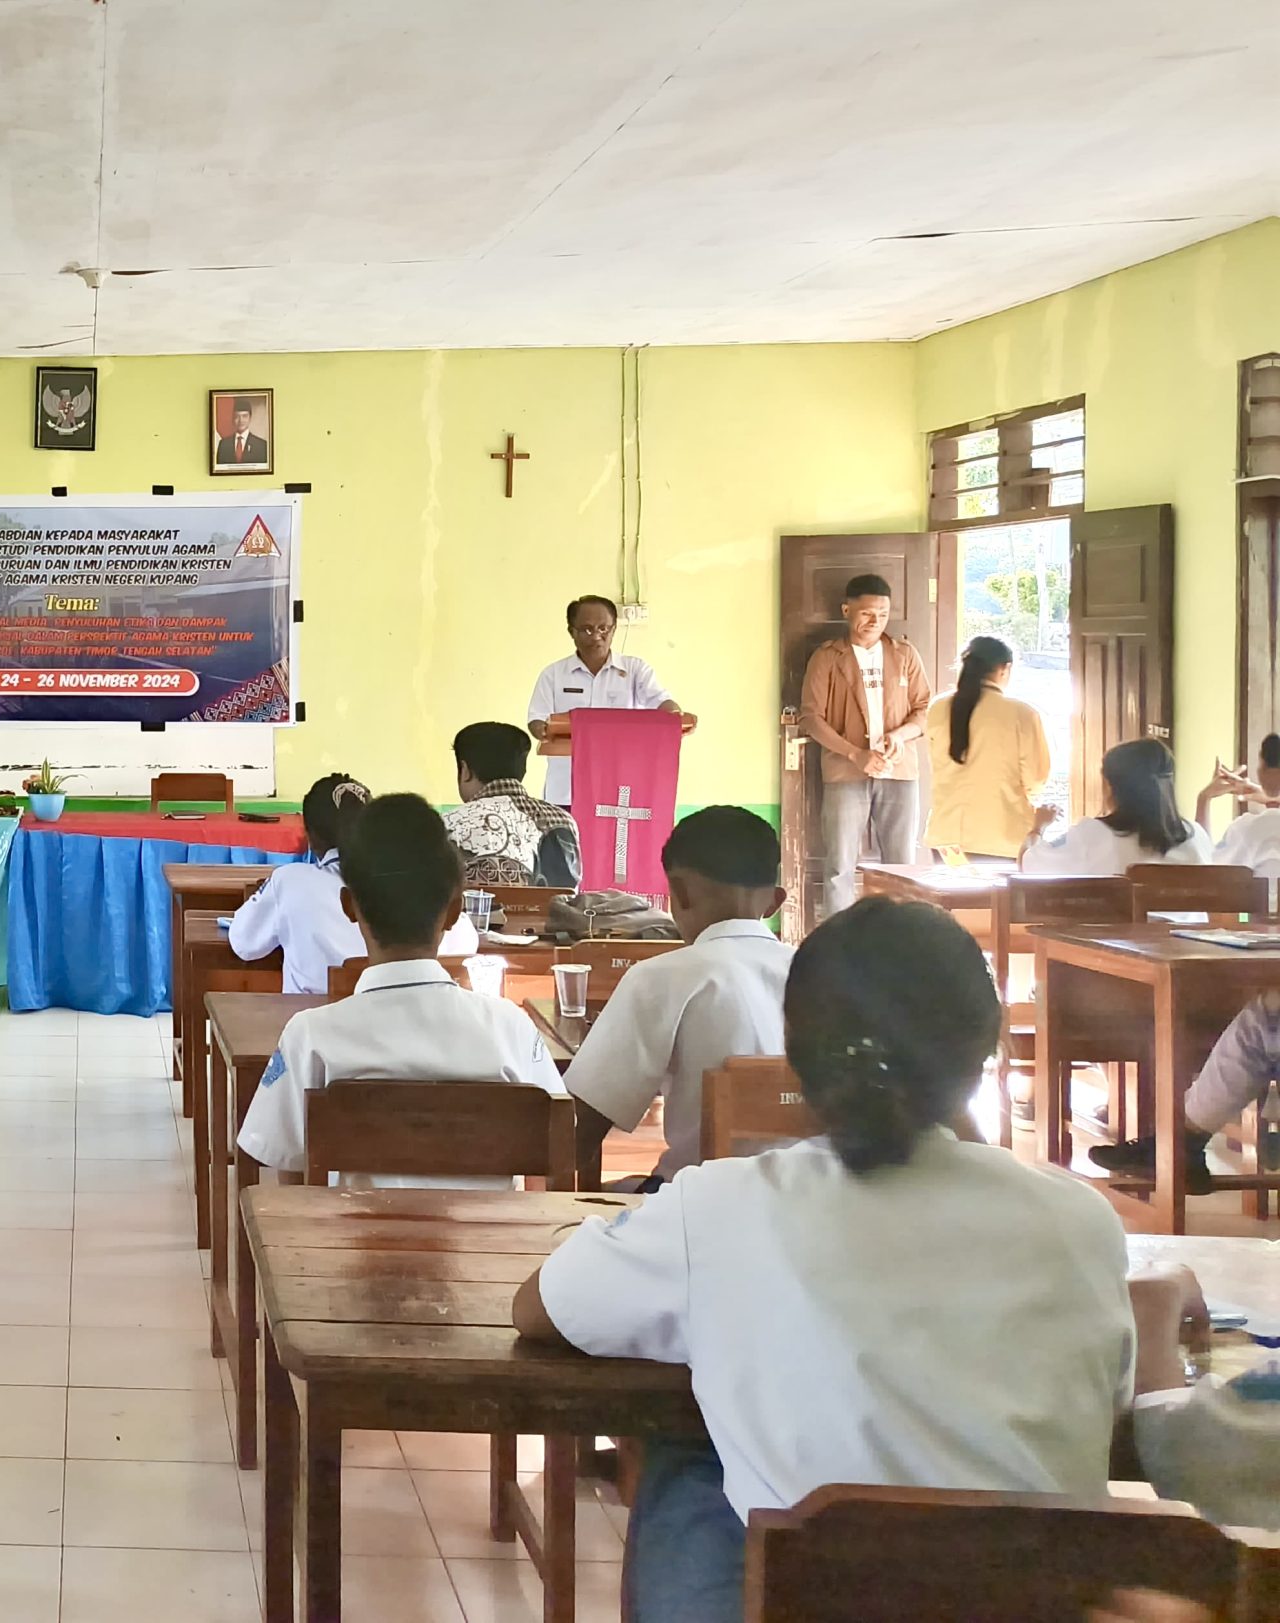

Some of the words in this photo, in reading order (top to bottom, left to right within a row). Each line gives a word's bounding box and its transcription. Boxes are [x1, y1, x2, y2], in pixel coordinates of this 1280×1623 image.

[45, 529, 93, 541] KEPADA
[96, 529, 181, 541] MASYARAKAT
[32, 544, 104, 556] PENDIDIKAN
[108, 544, 168, 556] PENYULUH
[172, 544, 216, 555] AGAMA
[45, 559, 70, 570] DAN
[73, 559, 102, 570] ILMU
[106, 559, 177, 570] PENDIDIKAN
[181, 559, 232, 570] KRISTEN
[4, 574, 48, 585] AGAMA
[51, 574, 101, 585] KRISTEN
[104, 574, 146, 585] NEGERI
[149, 574, 199, 585] KUPANG
[45, 593, 100, 611] Tema:
[55, 617, 121, 627] PENYULUHAN
[124, 617, 154, 627] ETIKA
[157, 617, 180, 627] DAN
[182, 617, 228, 627] DAMPAK
[66, 631, 128, 641] PERSPEKTIF
[131, 631, 169, 641] AGAMA
[172, 631, 217, 641] KRISTEN
[218, 631, 254, 642] UNTUK
[20, 646, 82, 656] KABUPATEN
[85, 646, 118, 656] TIMOR
[123, 646, 163, 656] TENGAH
[0, 674, 20, 687] 24
[37, 674, 55, 687] 26
[59, 673, 138, 688] NOVEMBER
[142, 674, 181, 688] 2024
